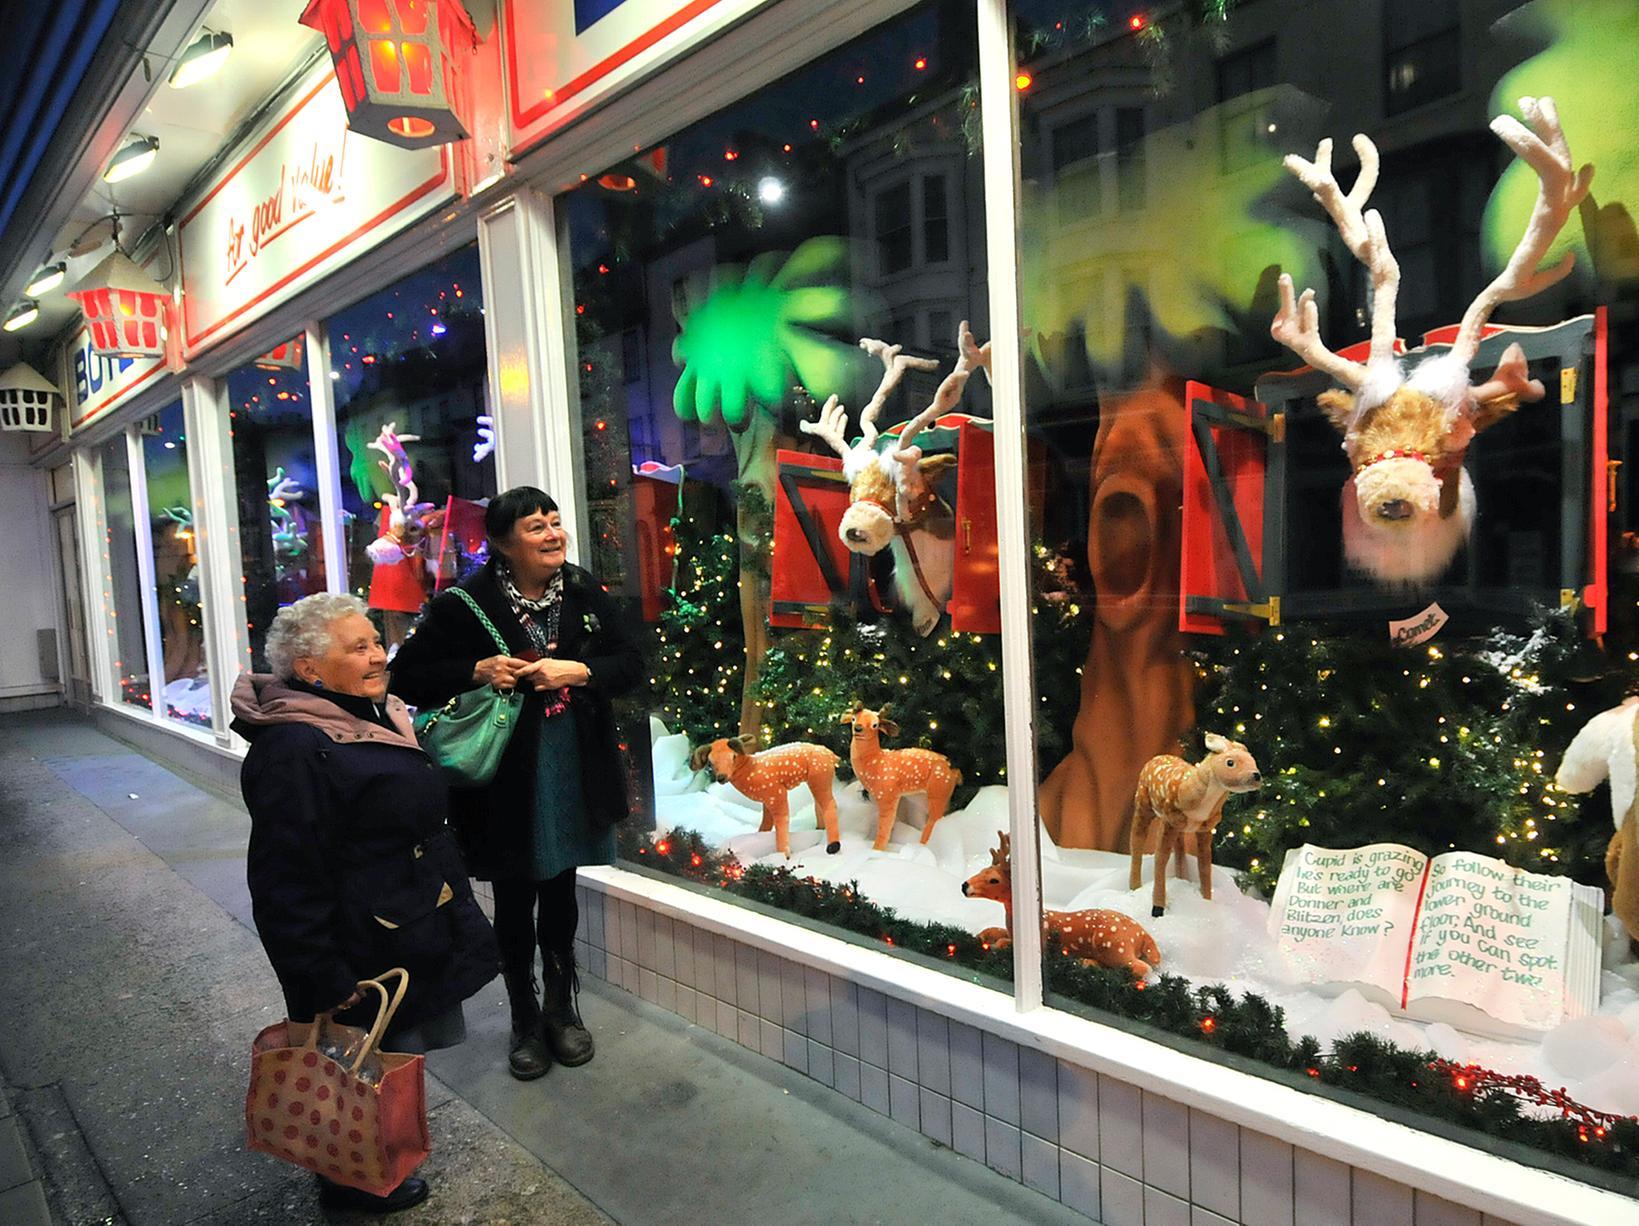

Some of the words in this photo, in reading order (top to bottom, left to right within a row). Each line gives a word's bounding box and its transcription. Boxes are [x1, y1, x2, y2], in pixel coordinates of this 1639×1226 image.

[249, 164, 285, 257] good
[1397, 613, 1441, 642] Comet
[1305, 852, 1346, 868] Cupid
[1353, 853, 1362, 864] is
[1365, 851, 1424, 875] grazing
[1330, 867, 1370, 883] ready
[1374, 866, 1390, 877] to
[1452, 859, 1504, 881] follow
[1513, 874, 1561, 892] their
[1297, 882, 1322, 894] But
[1327, 882, 1371, 895] where
[1378, 880, 1404, 892] are
[1426, 878, 1485, 900] journey
[1492, 886, 1512, 903] to
[1519, 894, 1549, 910] the
[1289, 896, 1344, 909] Donner
[1348, 895, 1372, 908] and
[1425, 895, 1465, 911] lower
[1469, 903, 1533, 927] ground
[1347, 908, 1383, 921] does
[1281, 925, 1336, 942] anyone
[1436, 930, 1470, 946] you
[1463, 916, 1496, 940] And
[1504, 934, 1539, 949] see
[1416, 949, 1440, 964] the
